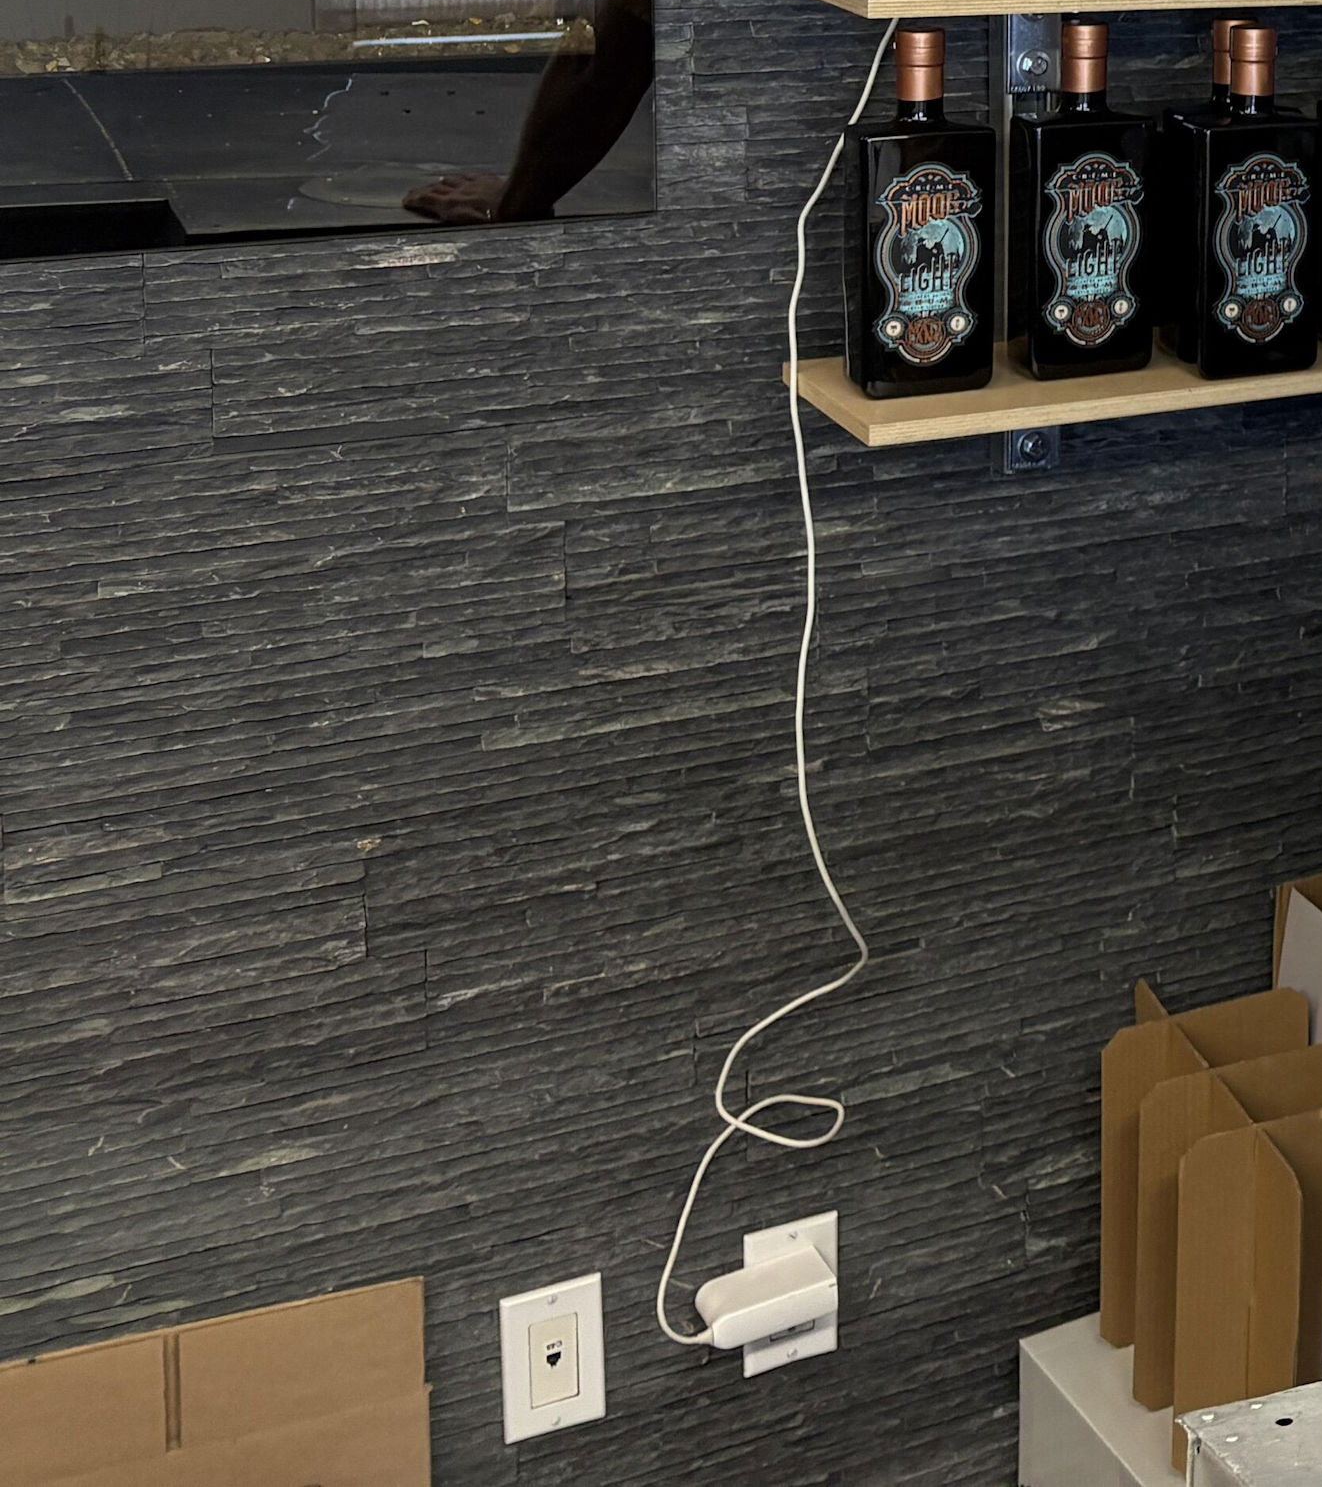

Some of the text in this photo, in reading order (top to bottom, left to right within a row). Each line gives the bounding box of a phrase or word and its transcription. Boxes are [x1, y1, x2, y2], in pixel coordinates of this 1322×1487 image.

[899, 253, 960, 292] LIGHT
[1066, 240, 1120, 276] LIGHT
[1236, 239, 1288, 276] LIGHT
